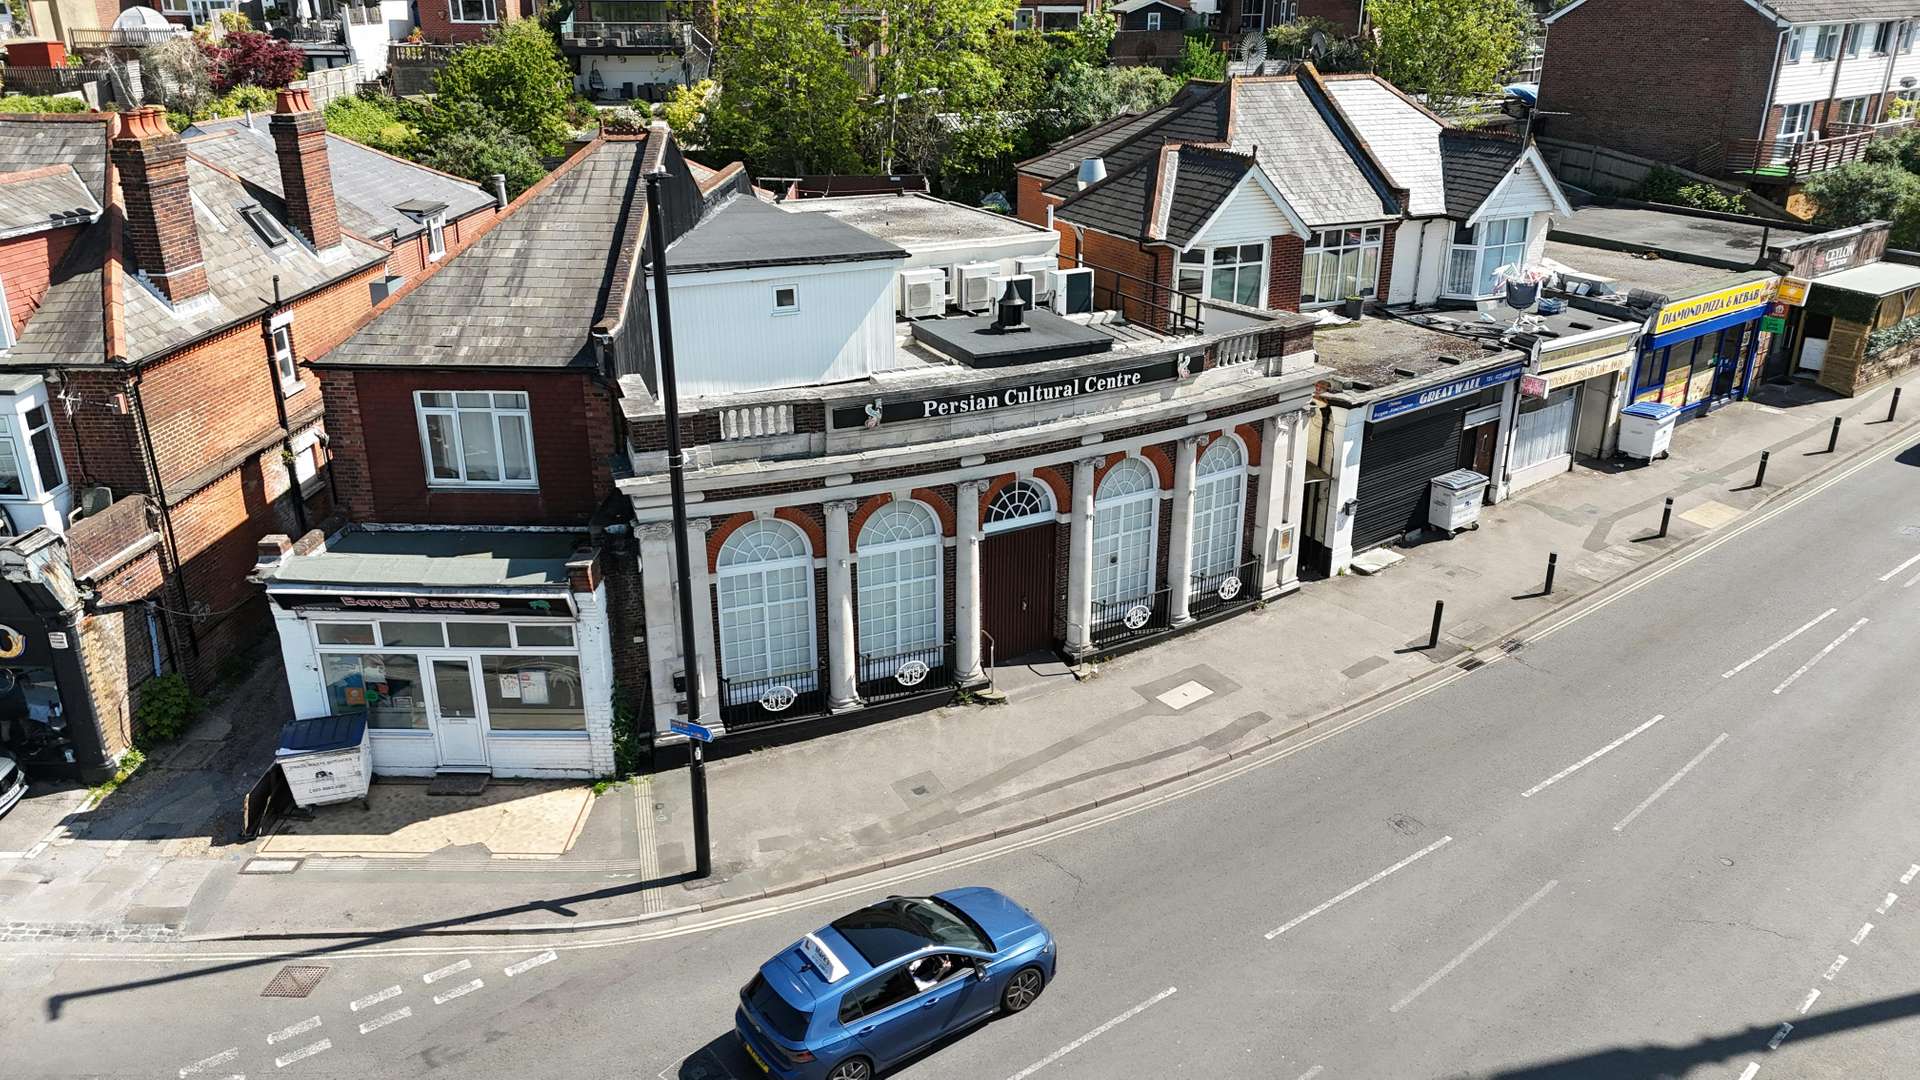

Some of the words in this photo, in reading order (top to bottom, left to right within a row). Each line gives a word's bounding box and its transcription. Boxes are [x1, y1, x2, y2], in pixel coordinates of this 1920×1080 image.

[1826, 244, 1855, 262] CEYLON
[1662, 303, 1702, 325] DIAMOND
[1702, 299, 1724, 314] PIZZA
[1726, 297, 1732, 308] &
[1732, 289, 1760, 306] KEBAB
[923, 394, 998, 417] Persian
[1004, 378, 1079, 406] Cultural
[1084, 370, 1141, 393] Centre
[1419, 384, 1455, 405] GREAT
[1455, 377, 1481, 395] WALL
[340, 596, 410, 609] Bengal
[415, 597, 502, 610] Paradise
